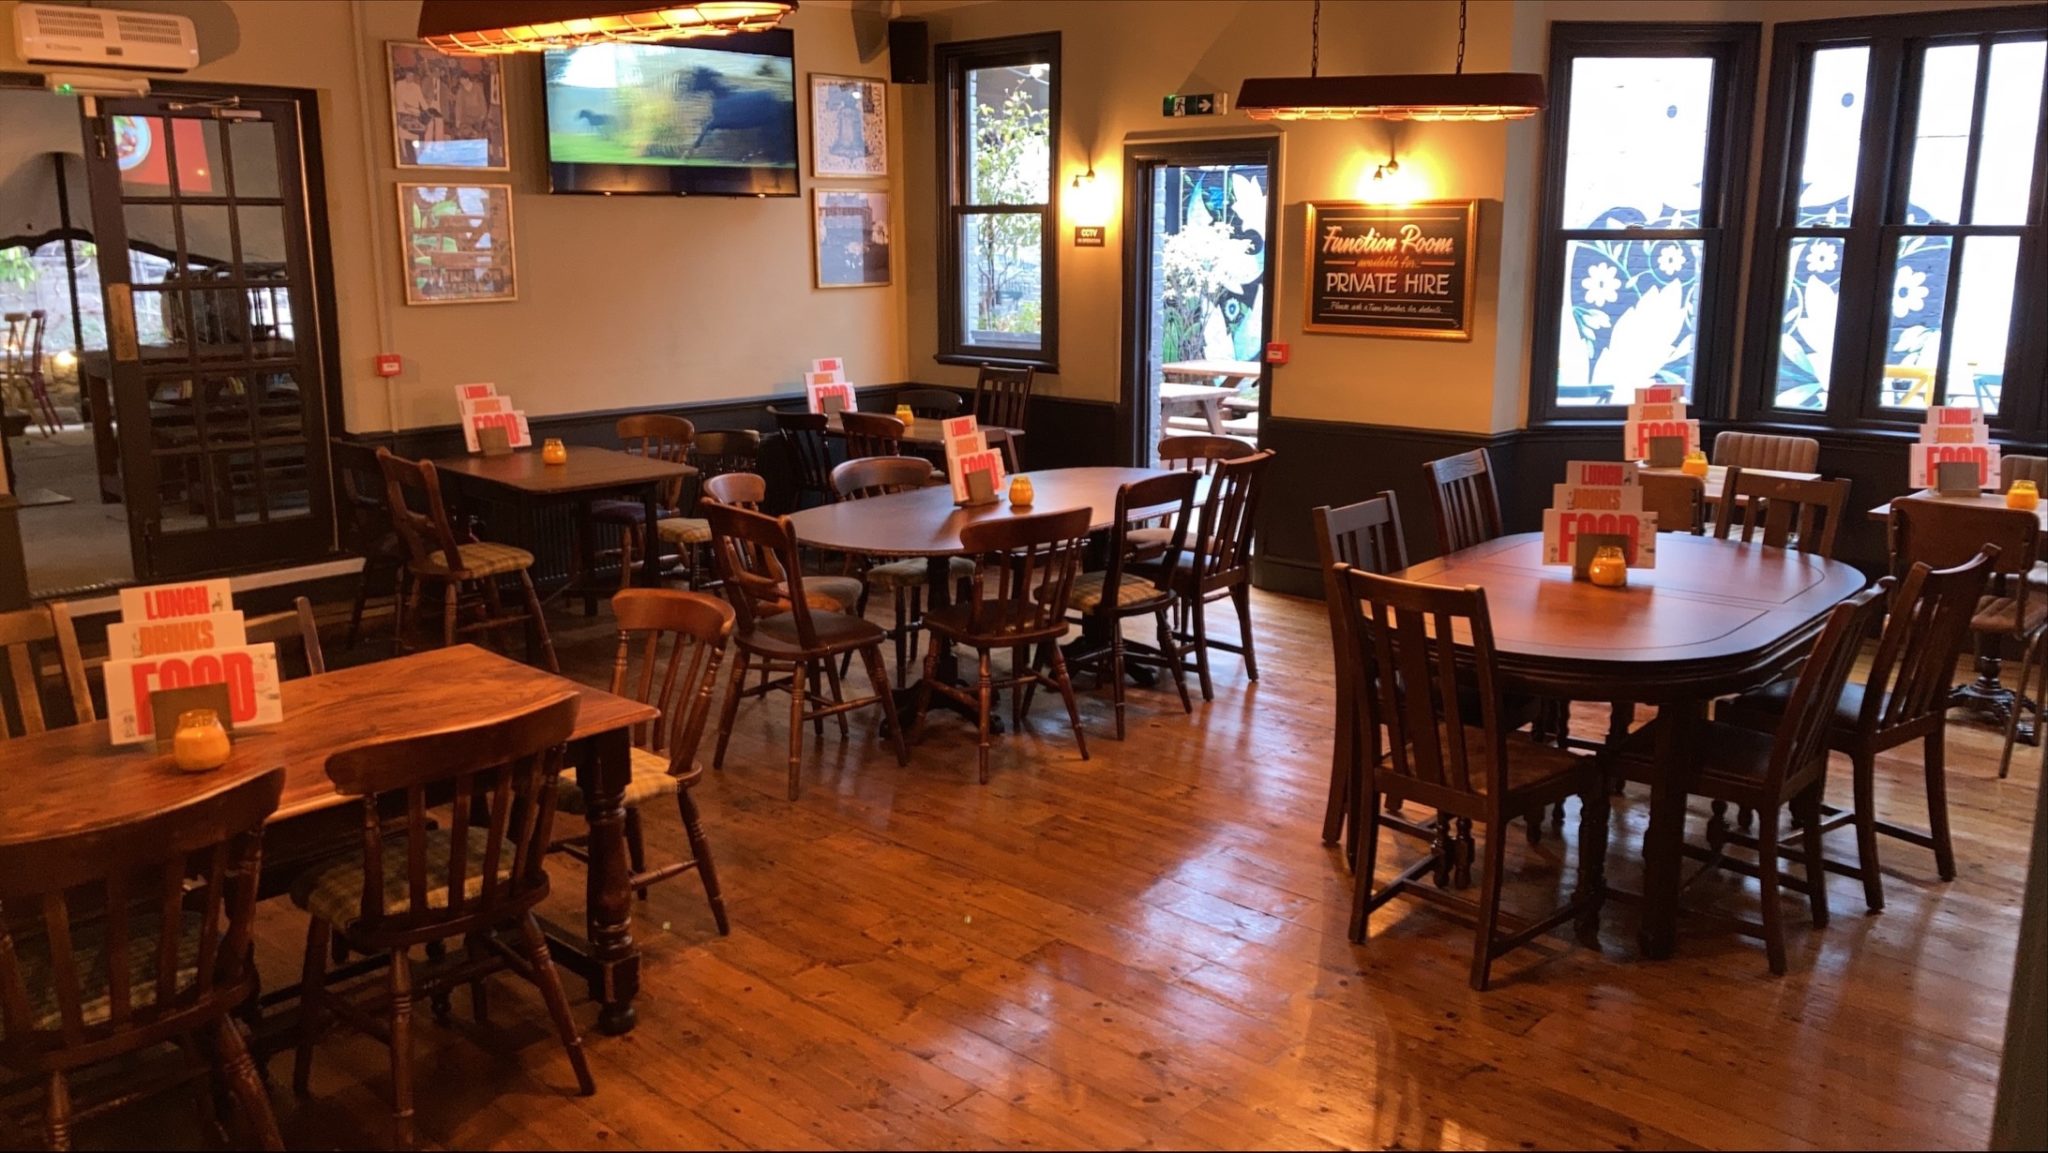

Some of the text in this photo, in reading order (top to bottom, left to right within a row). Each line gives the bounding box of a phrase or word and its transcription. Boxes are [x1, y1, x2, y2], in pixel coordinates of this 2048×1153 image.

[1081, 228, 1099, 238] CCTV
[1322, 223, 1455, 254] Function Room
[1356, 255, 1399, 268] available
[1325, 272, 1450, 295] PRIVATE HIRE
[1580, 464, 1625, 486] LUNCH
[144, 585, 210, 621] LUNCH
[138, 619, 215, 657] DRINKS
